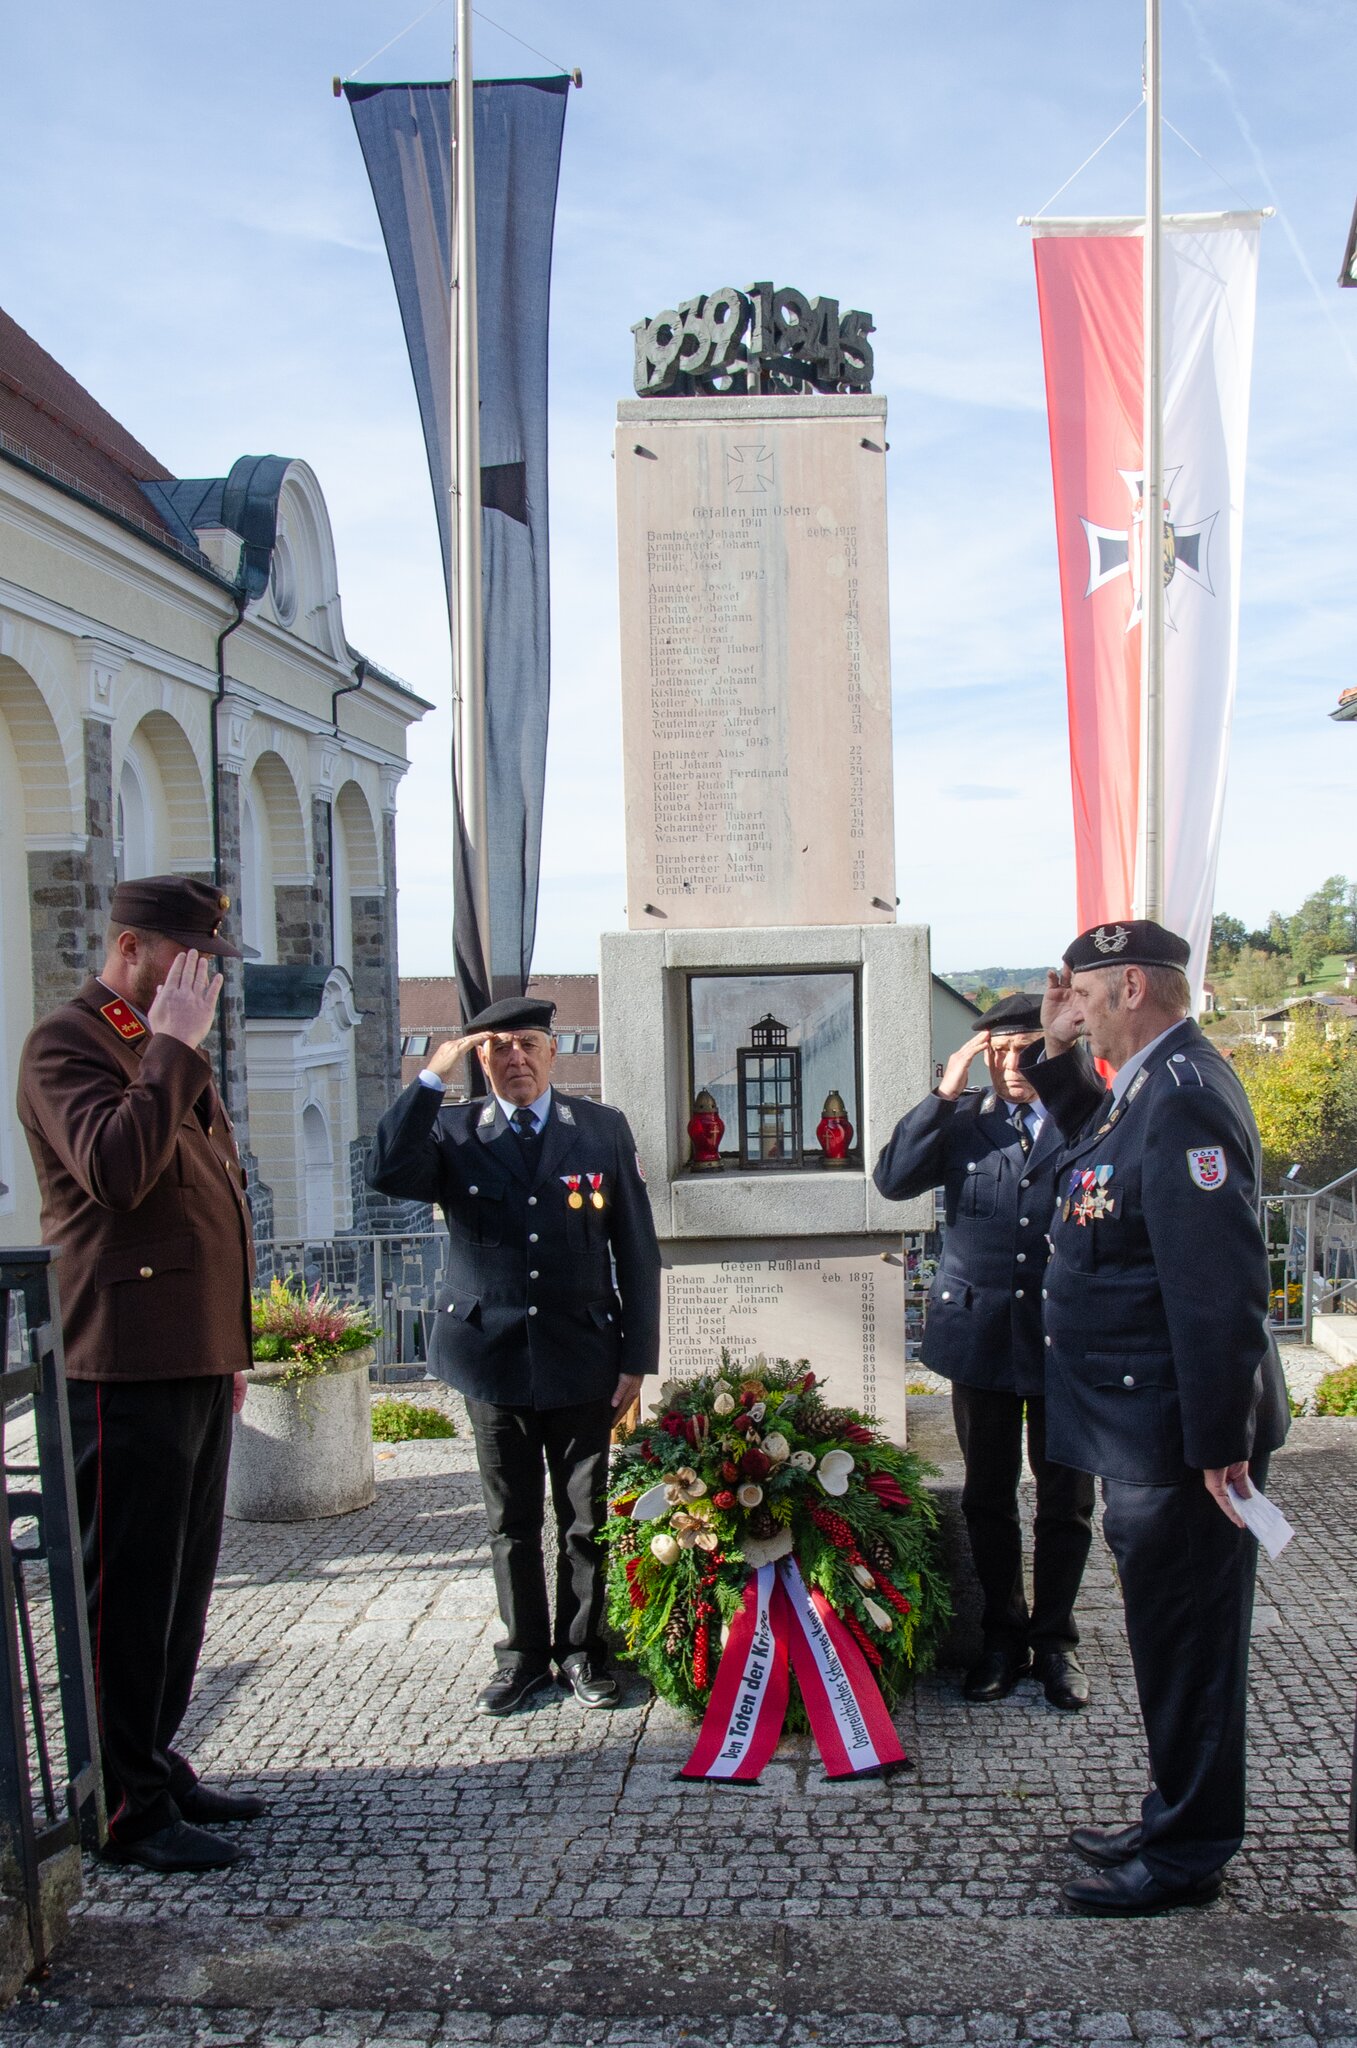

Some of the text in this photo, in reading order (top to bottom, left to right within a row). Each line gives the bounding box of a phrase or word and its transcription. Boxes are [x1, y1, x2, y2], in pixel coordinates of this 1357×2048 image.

[630, 286, 750, 397] 1939
[692, 507, 746, 519] Gefallen
[751, 505, 768, 518] im
[649, 584, 695, 593] Auinger
[709, 592, 740, 602] Josef
[650, 613, 753, 624] Eichinger Johann
[650, 625, 689, 635] Fischer
[728, 644, 764, 654] Hubert
[650, 656, 683, 667] Hofer
[715, 676, 758, 685] Johann
[651, 688, 703, 698] Kislinger
[710, 686, 738, 696] Alois
[651, 698, 687, 708] Koller
[739, 706, 776, 717] Hubert
[724, 717, 759, 728] Alfred
[652, 729, 715, 740] Wipplinger
[721, 727, 752, 737] Josef
[715, 748, 745, 758] Alois
[653, 761, 673, 770] Ertl
[680, 760, 722, 769] Johann
[730, 767, 789, 779] Ferdinand
[654, 781, 688, 791] Koller
[697, 779, 734, 790] Rudolf
[654, 792, 689, 802] Koller
[696, 791, 737, 801] Johann
[697, 801, 734, 811] Martin
[725, 810, 763, 821] Hubert
[655, 823, 717, 833] Scharinger
[655, 829, 864, 843] Wasner Ferdinand 09
[656, 854, 719, 864] Dirnberger
[727, 852, 754, 862] Alois
[656, 864, 720, 874] Dirnberger
[727, 862, 764, 872] Martin
[724, 873, 766, 883] Ludwig
[721, 1259, 821, 1273] Gegen Rußland
[667, 1271, 874, 1285] Beham Johann geb. 1897
[667, 1283, 874, 1295] Brunbauer Heinrich 95
[668, 1293, 875, 1305] Brunbauer Johann 92
[667, 1303, 875, 1316] Eichinger Alois 96
[668, 1313, 875, 1325] Ertl Josef 90
[668, 1323, 875, 1336] Ertl Josef 90
[668, 1333, 875, 1346] Fuchs Matthias 88
[669, 1346, 712, 1356] Grömer
[862, 1343, 875, 1353] 90
[862, 1354, 875, 1363] 86
[669, 1366, 698, 1377] Haas
[862, 1363, 875, 1373] 83
[863, 1373, 876, 1383] 90
[863, 1384, 876, 1393] 96
[863, 1394, 876, 1403] 93
[819, 1633, 844, 1683] Schwarzes
[741, 1660, 766, 1691] der
[728, 1693, 757, 1738] Toten
[834, 1679, 870, 1750] Österreichisches
[720, 1739, 744, 1760] Den
